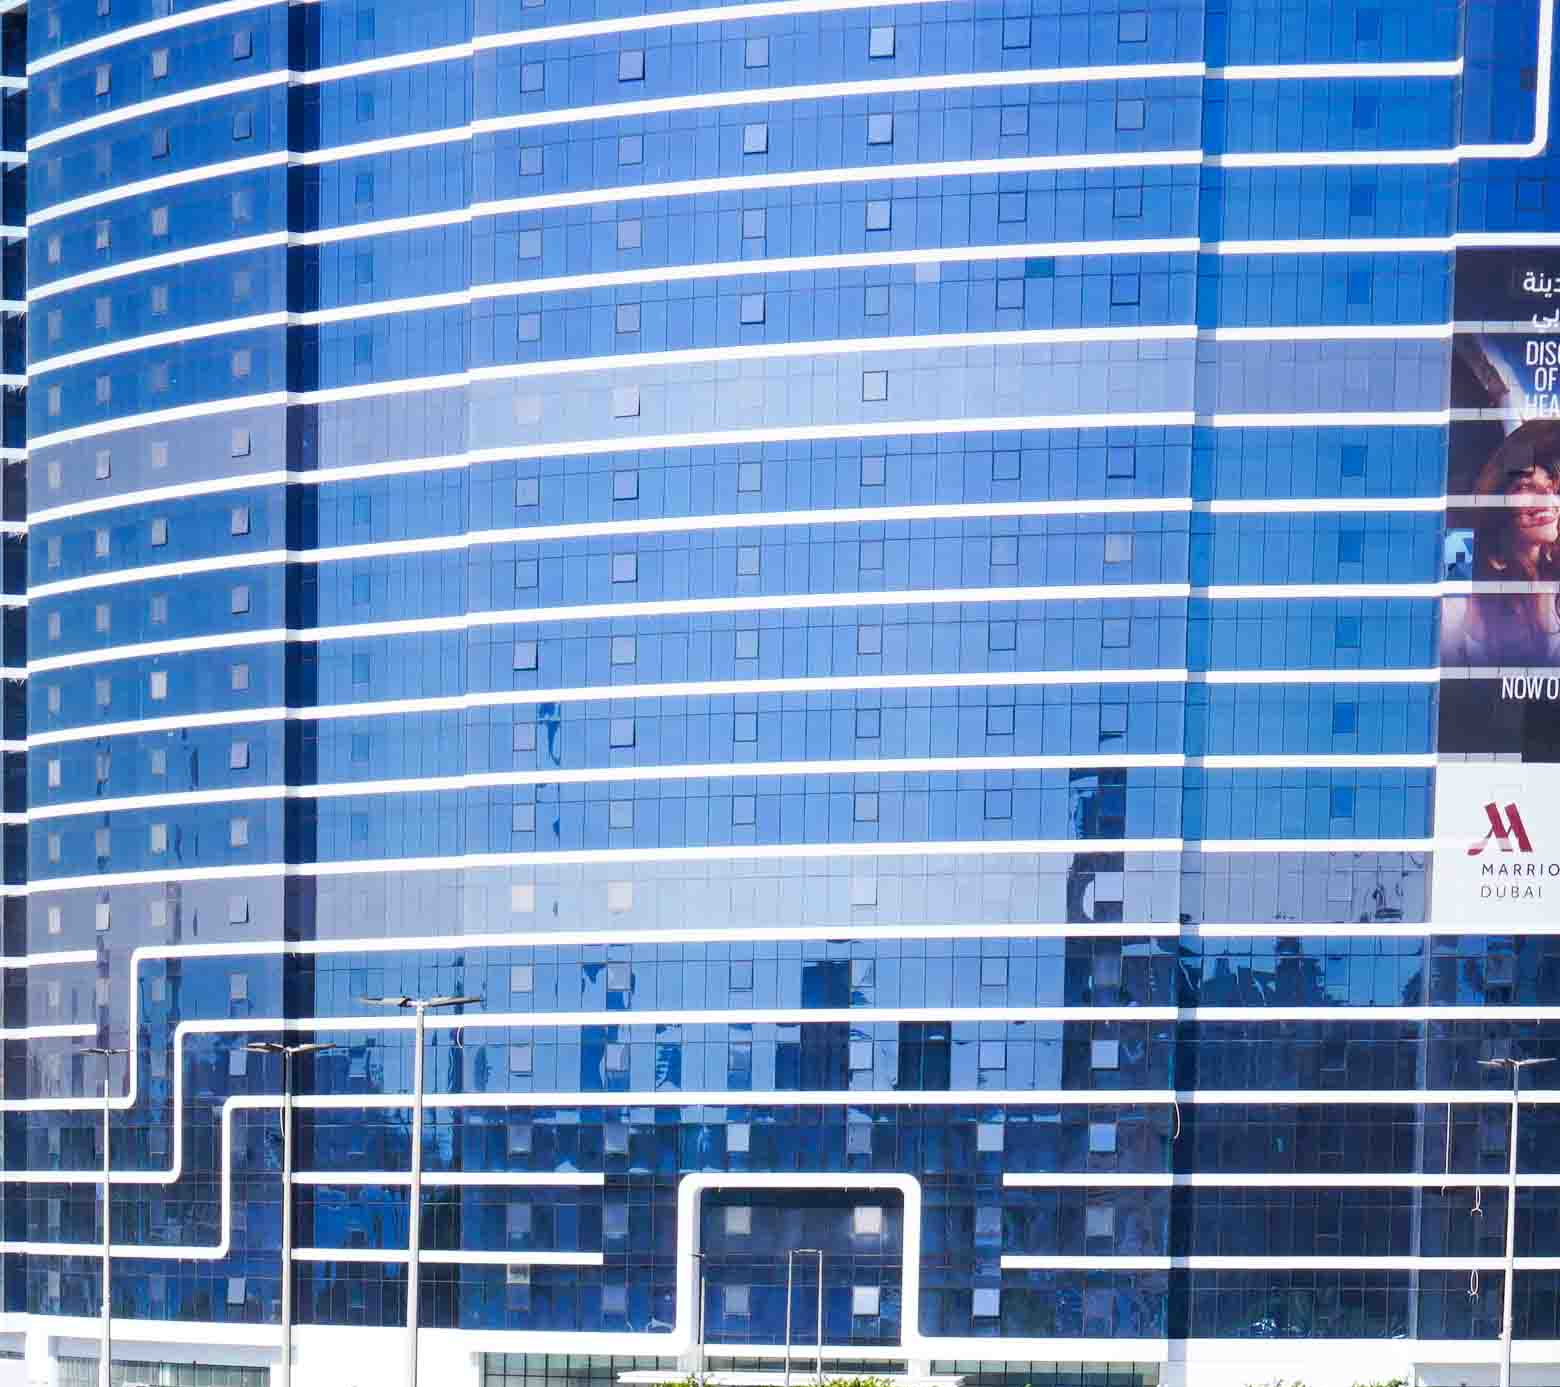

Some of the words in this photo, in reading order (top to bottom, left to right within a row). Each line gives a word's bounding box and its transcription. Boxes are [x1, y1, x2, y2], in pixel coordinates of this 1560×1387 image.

[1534, 367, 1557, 392] OF
[1501, 675, 1545, 700] NOW
[1480, 885, 1543, 898] DUBAI
